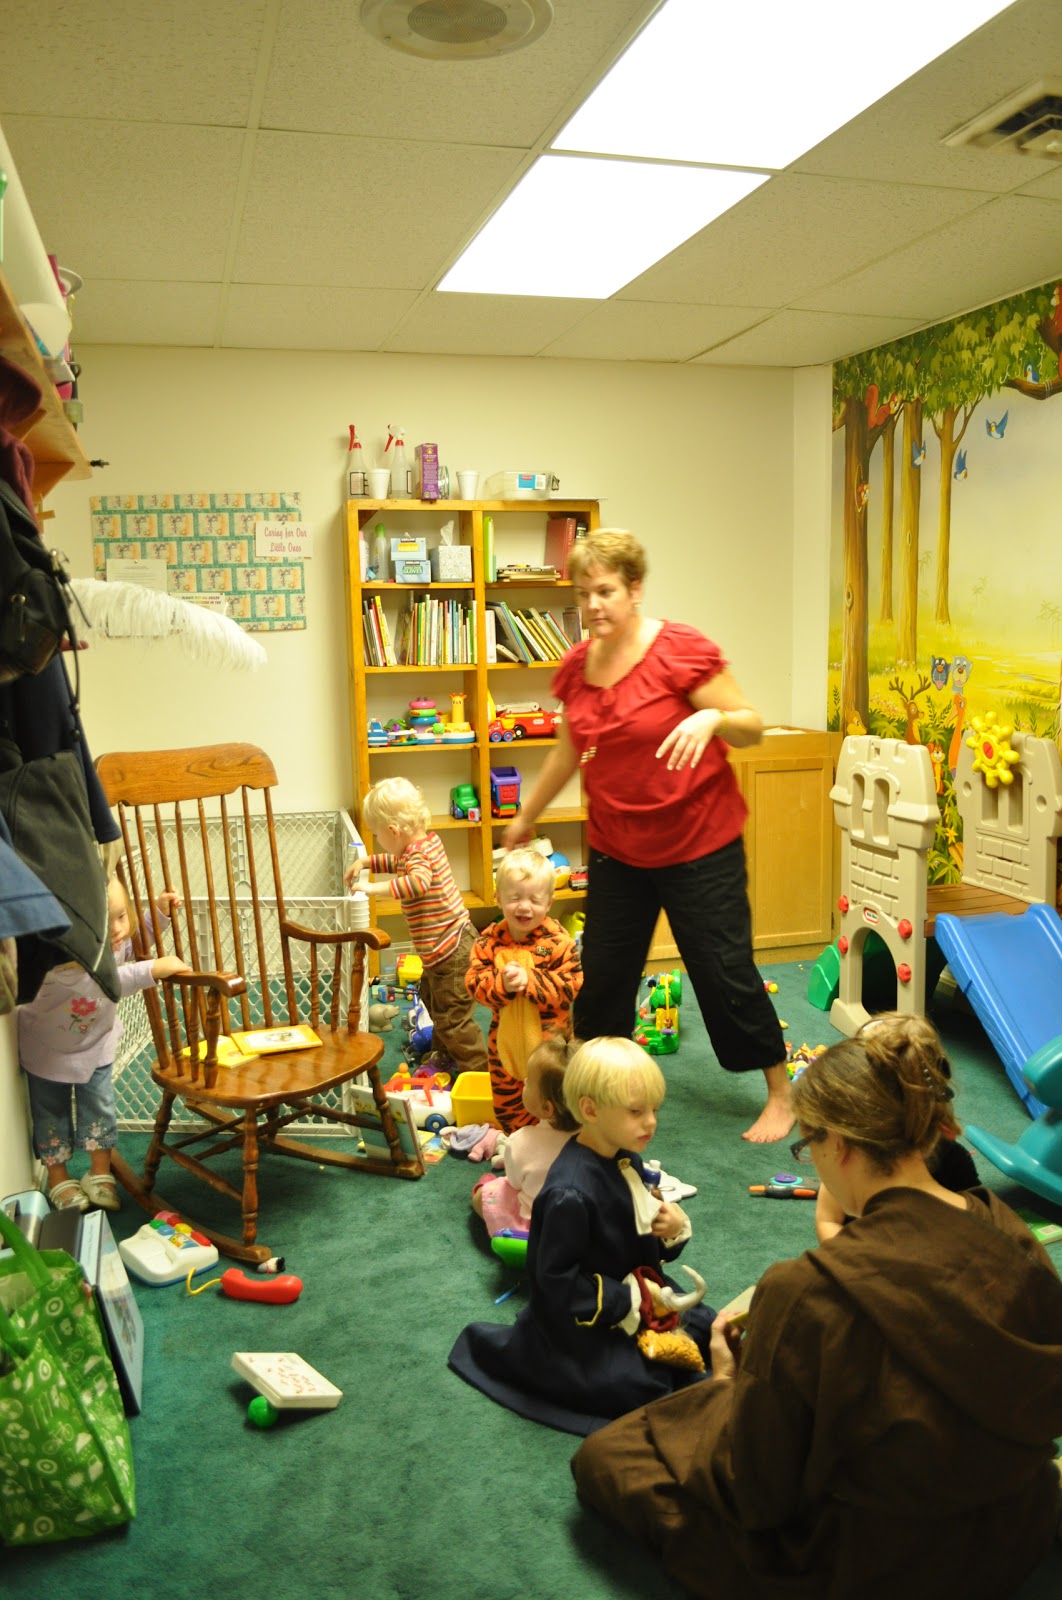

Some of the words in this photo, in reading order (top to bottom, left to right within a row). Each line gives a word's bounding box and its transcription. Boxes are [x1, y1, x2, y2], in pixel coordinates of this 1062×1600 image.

[264, 527, 283, 539] Caring
[285, 527, 294, 539] for
[296, 528, 307, 538] Our
[270, 542, 286, 552] Little
[288, 542, 302, 552] Ones
